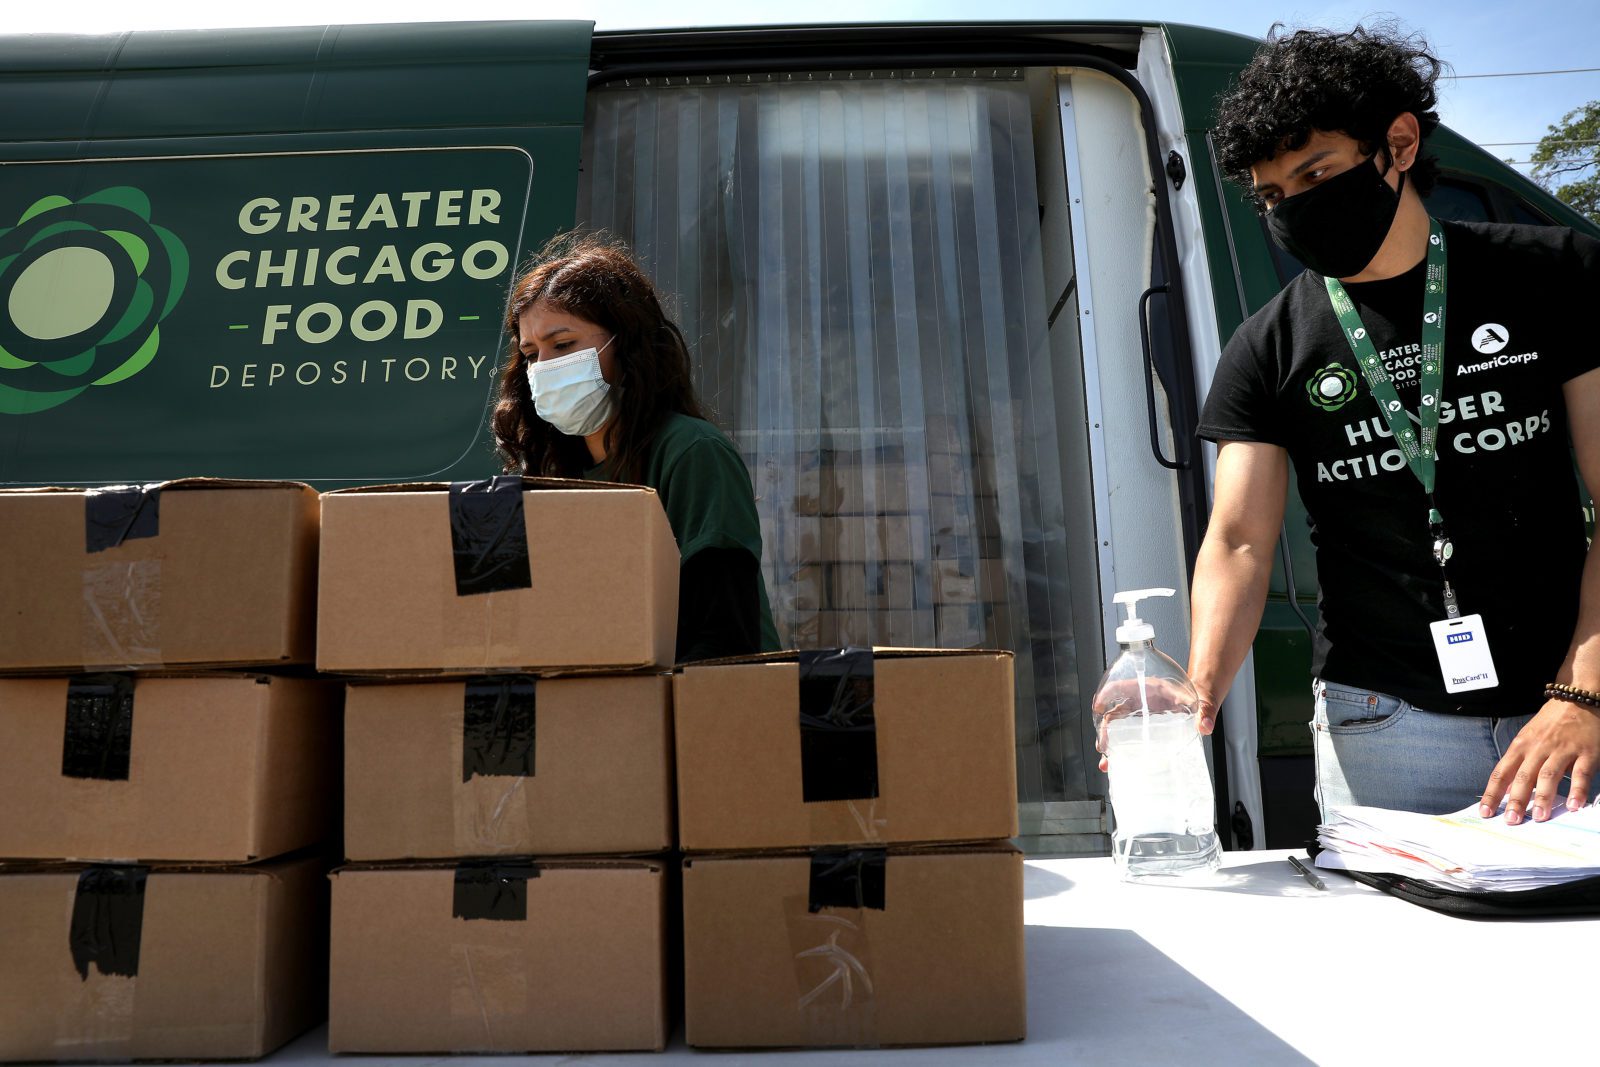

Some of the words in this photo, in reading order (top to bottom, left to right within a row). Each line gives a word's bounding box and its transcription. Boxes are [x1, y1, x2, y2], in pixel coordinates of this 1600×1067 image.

[238, 189, 502, 235] GREATER
[215, 240, 509, 290] CHICAGO
[261, 299, 444, 345] FOOD
[209, 355, 487, 389] DEPOSITORY
[1379, 343, 1421, 361] EATER
[1456, 351, 1539, 376] AmeriCorps
[1317, 448, 1440, 483] ACTIO
[1453, 409, 1550, 455] CORPS
[1449, 633, 1471, 643] HID
